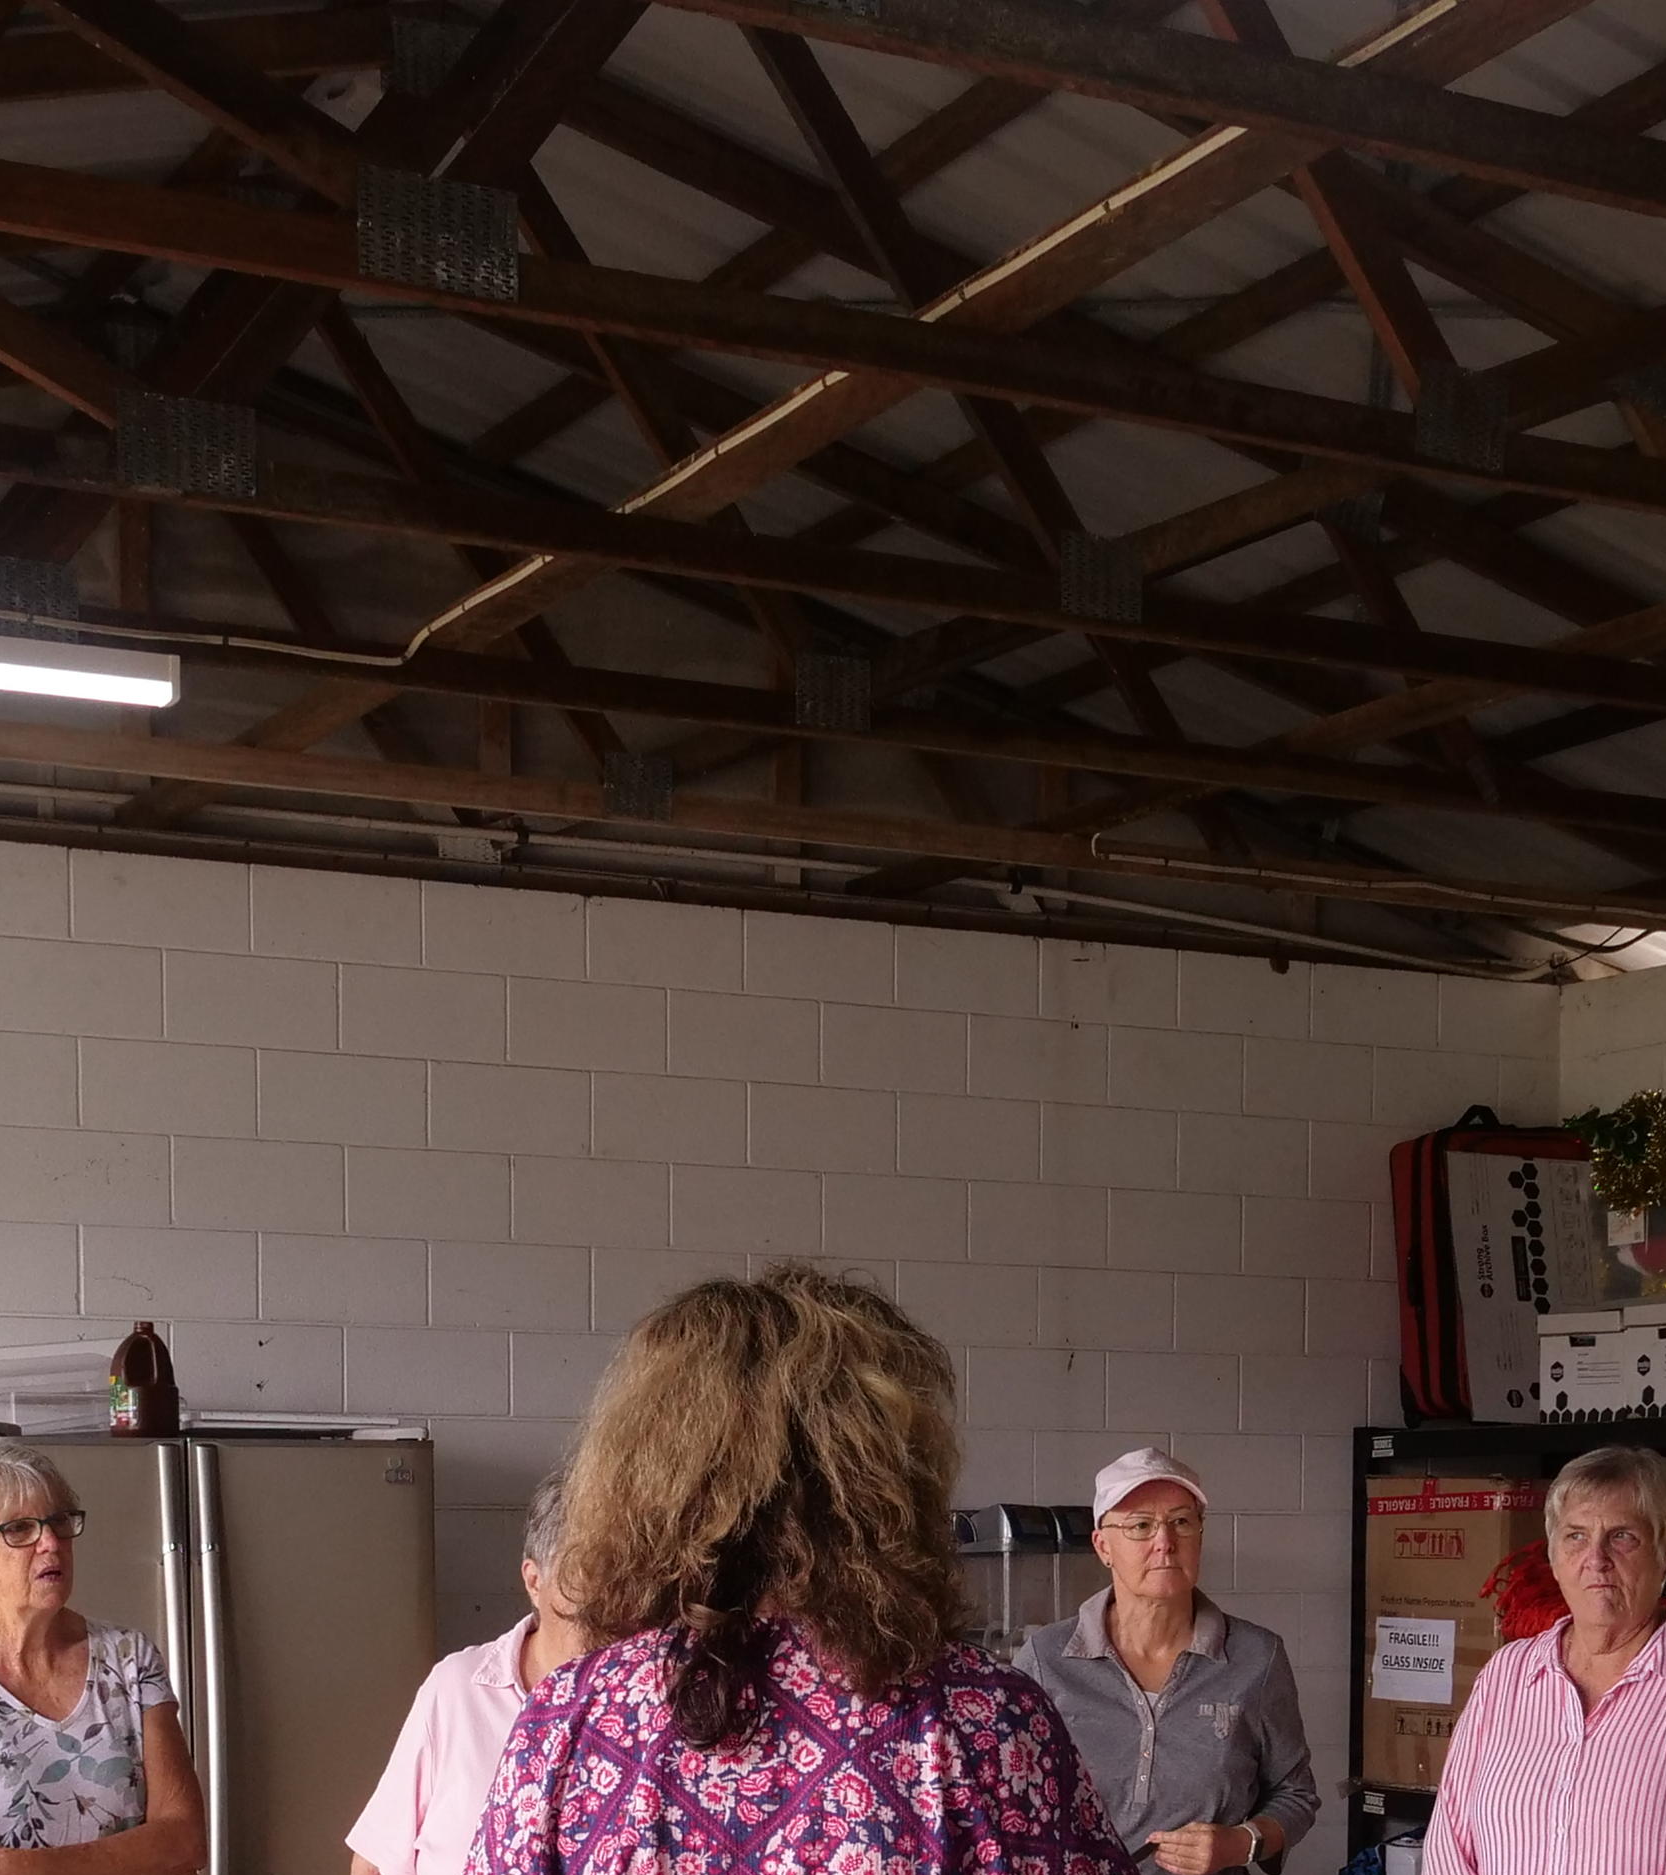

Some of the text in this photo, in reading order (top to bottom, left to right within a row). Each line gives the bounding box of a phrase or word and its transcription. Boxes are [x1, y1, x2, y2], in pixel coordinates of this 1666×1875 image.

[1377, 1499, 1417, 1512] FRAGILE
[1429, 1496, 1470, 1510] FRAGILE
[1388, 1632, 1440, 1648] FRAGILE!!!
[1381, 1654, 1445, 1671] GLASS INSIDE
